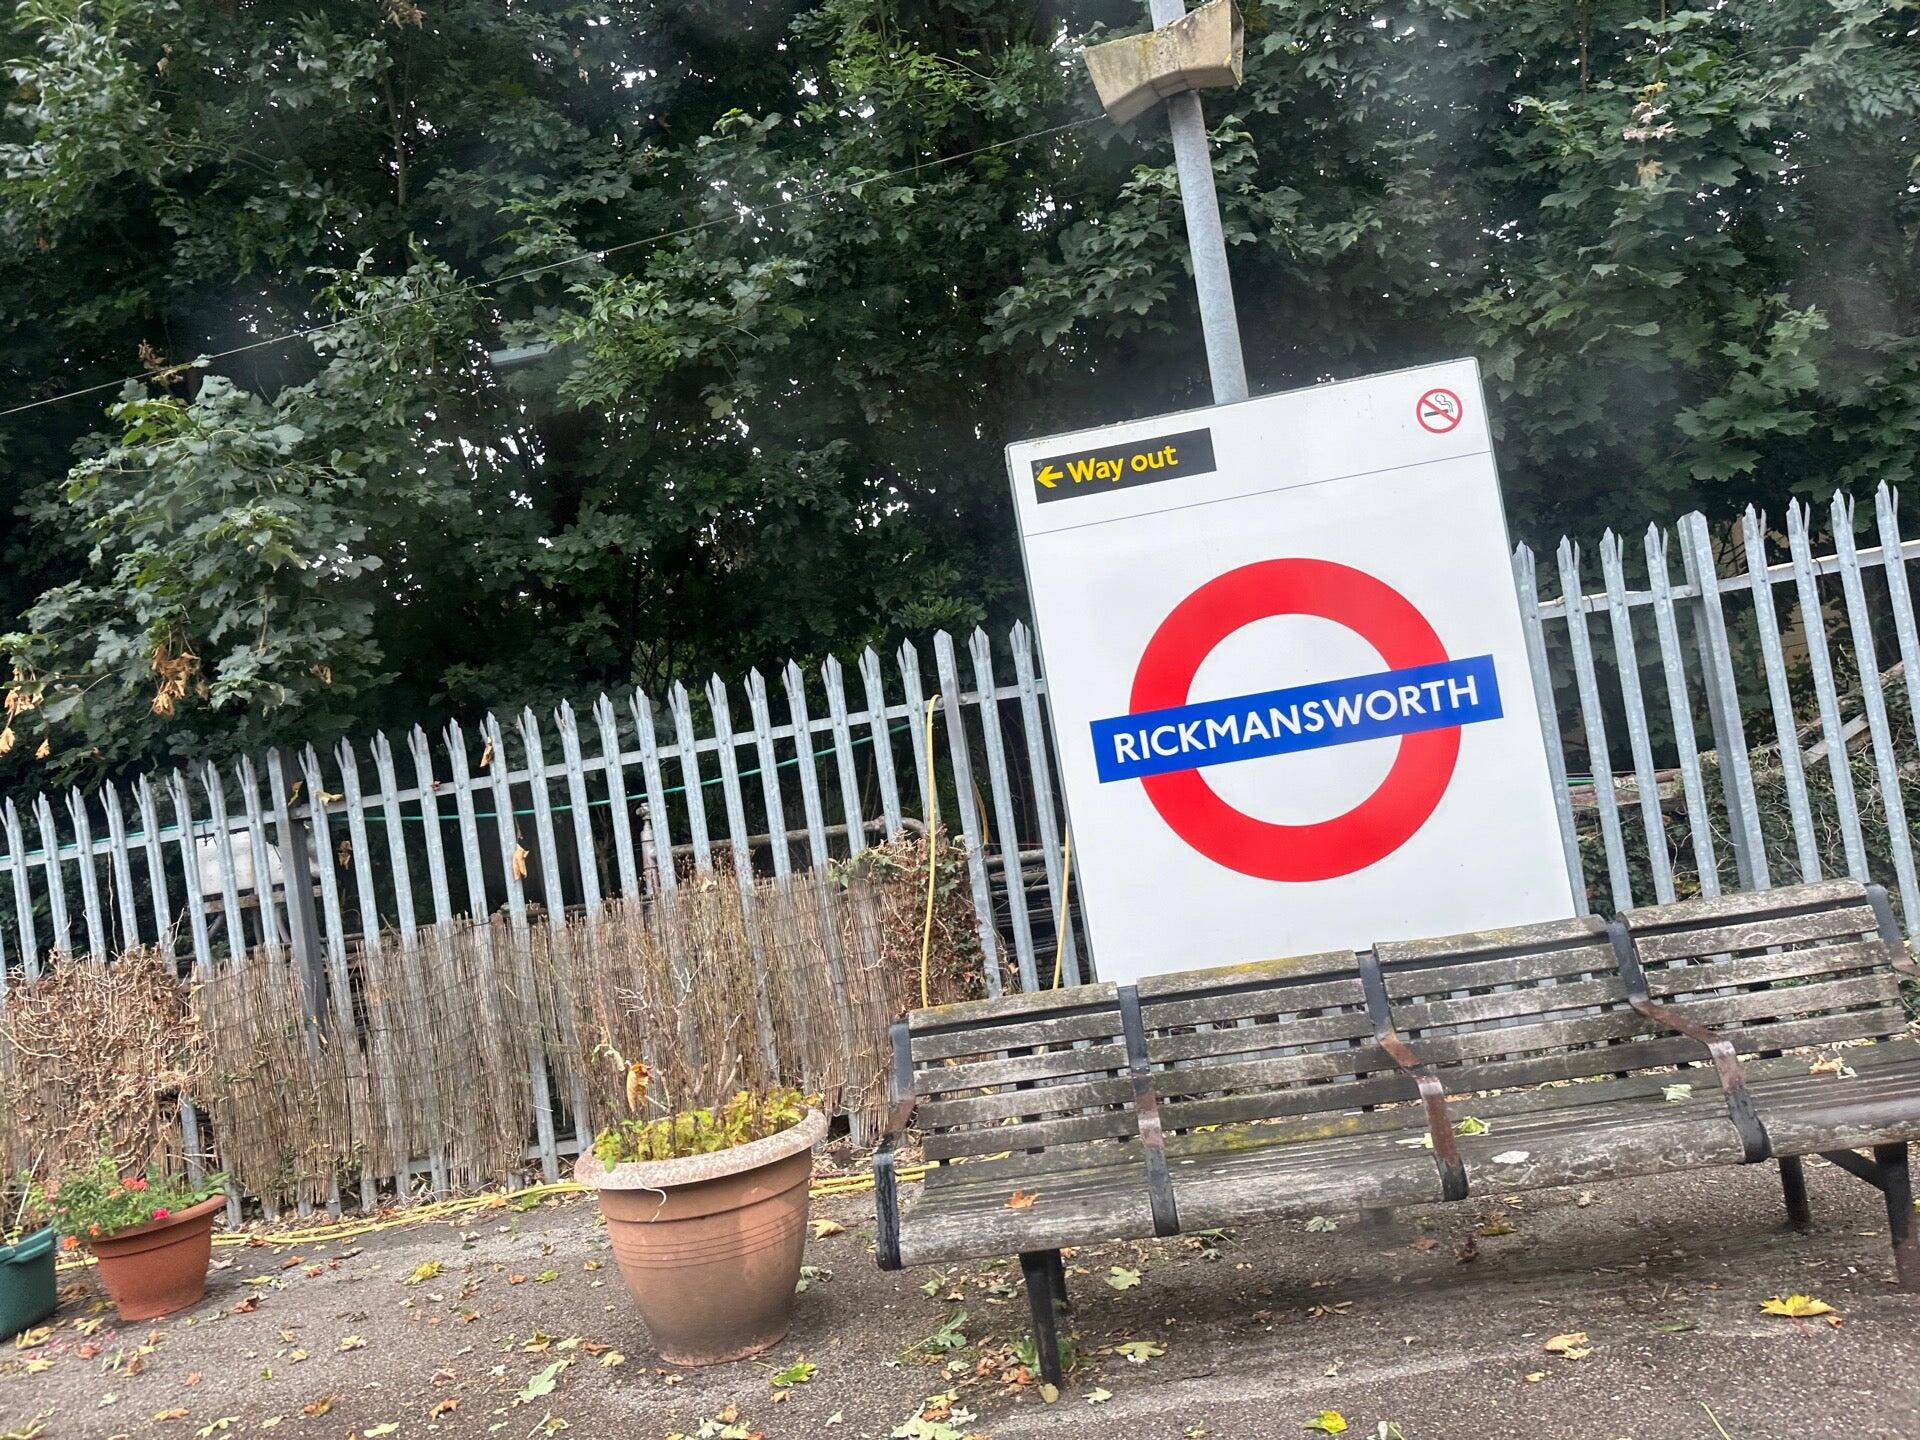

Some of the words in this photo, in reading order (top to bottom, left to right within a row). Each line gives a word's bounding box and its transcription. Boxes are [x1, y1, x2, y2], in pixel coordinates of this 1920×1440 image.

[1066, 457, 1125, 483] Way
[1131, 446, 1178, 472] out
[1113, 675, 1479, 763] RICKMANSWORTH
